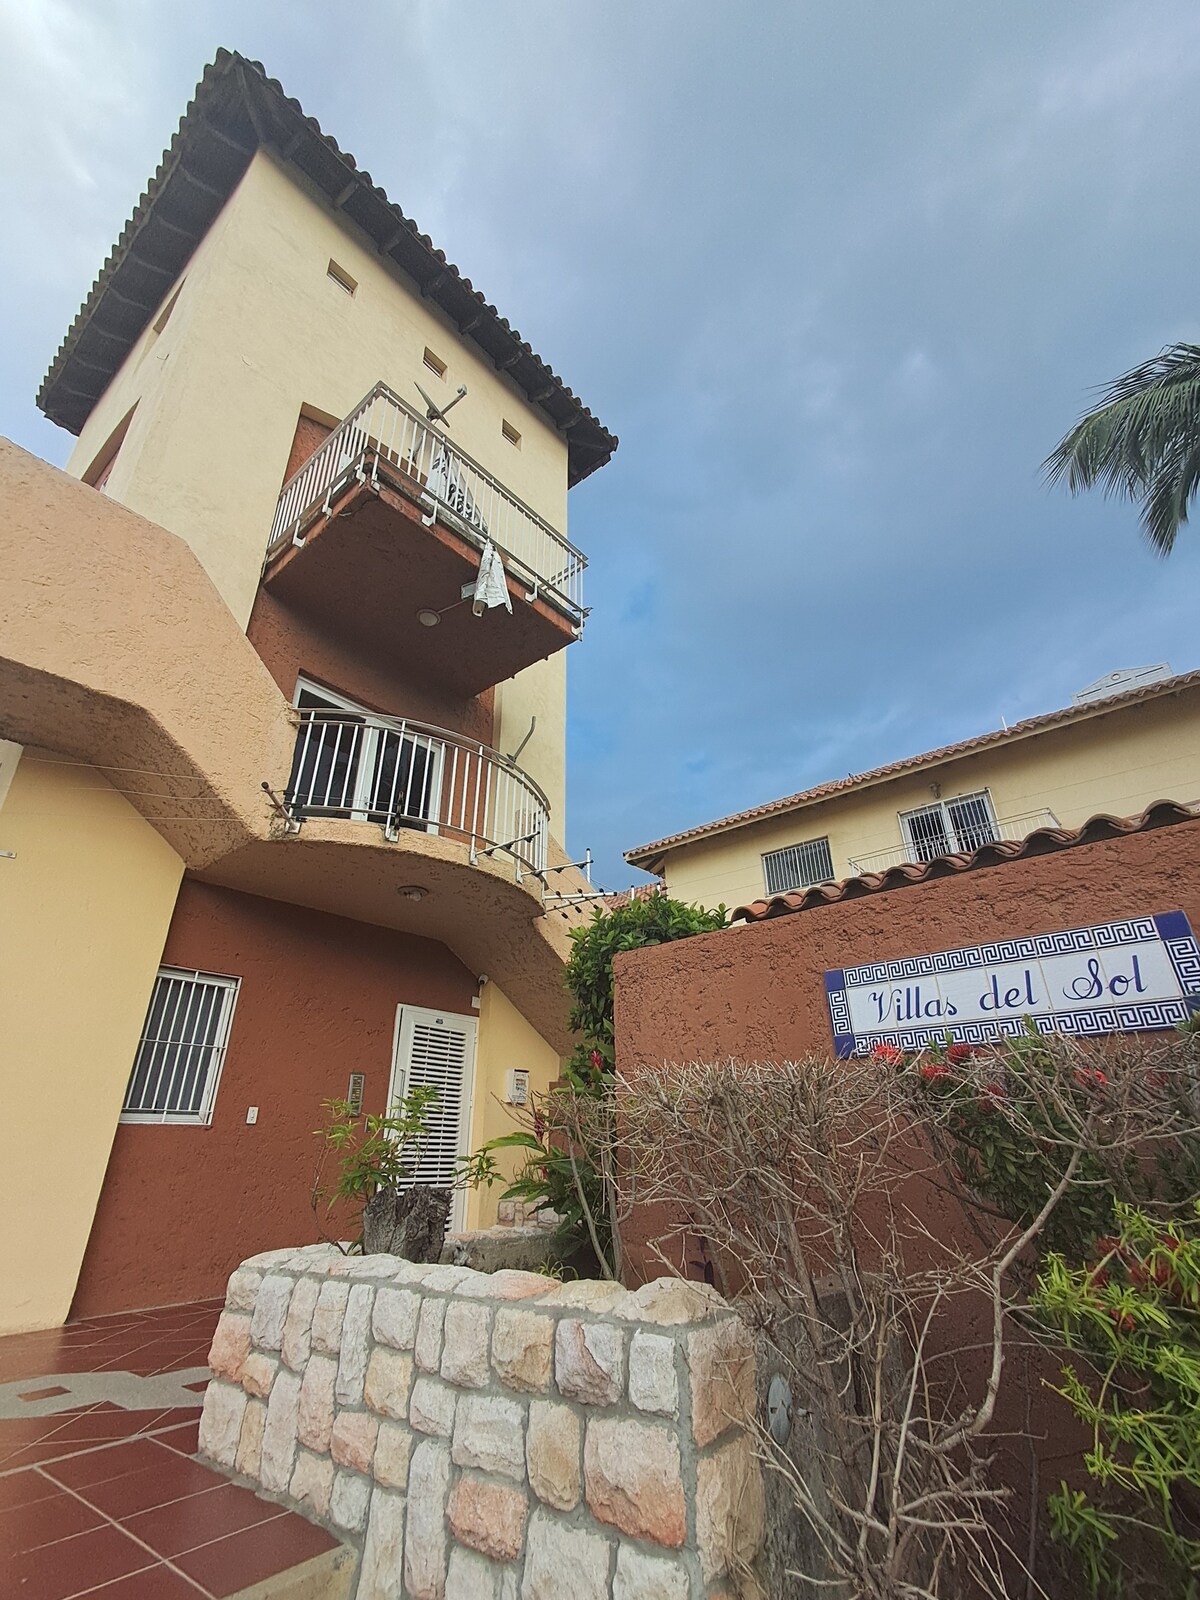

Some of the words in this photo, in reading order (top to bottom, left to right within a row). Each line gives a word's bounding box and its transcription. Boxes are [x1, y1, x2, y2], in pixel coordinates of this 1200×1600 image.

[868, 986, 958, 1024] Villas
[979, 969, 1039, 1011] del
[1062, 954, 1149, 1001] Sol
